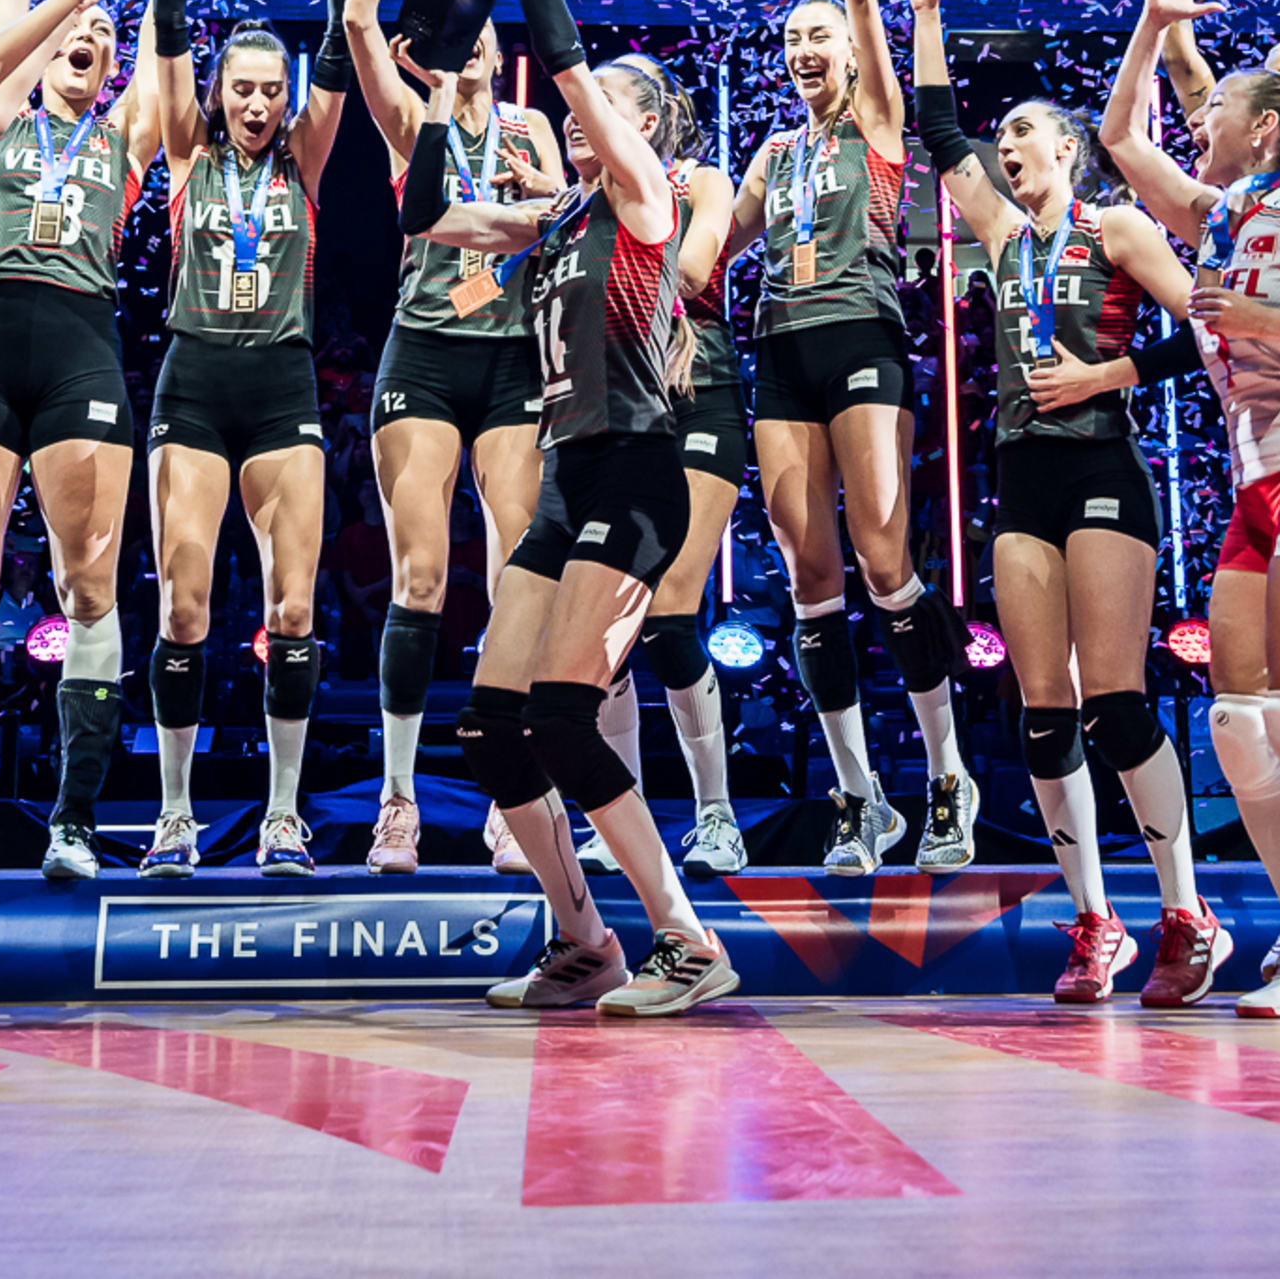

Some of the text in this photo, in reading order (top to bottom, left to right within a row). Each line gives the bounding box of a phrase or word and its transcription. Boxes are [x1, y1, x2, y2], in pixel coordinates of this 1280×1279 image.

[5, 147, 116, 190] VETEL
[765, 166, 847, 221] EEL
[194, 200, 298, 234] VEEL
[380, 391, 407, 413] 12
[152, 919, 500, 959] THE FINALS
